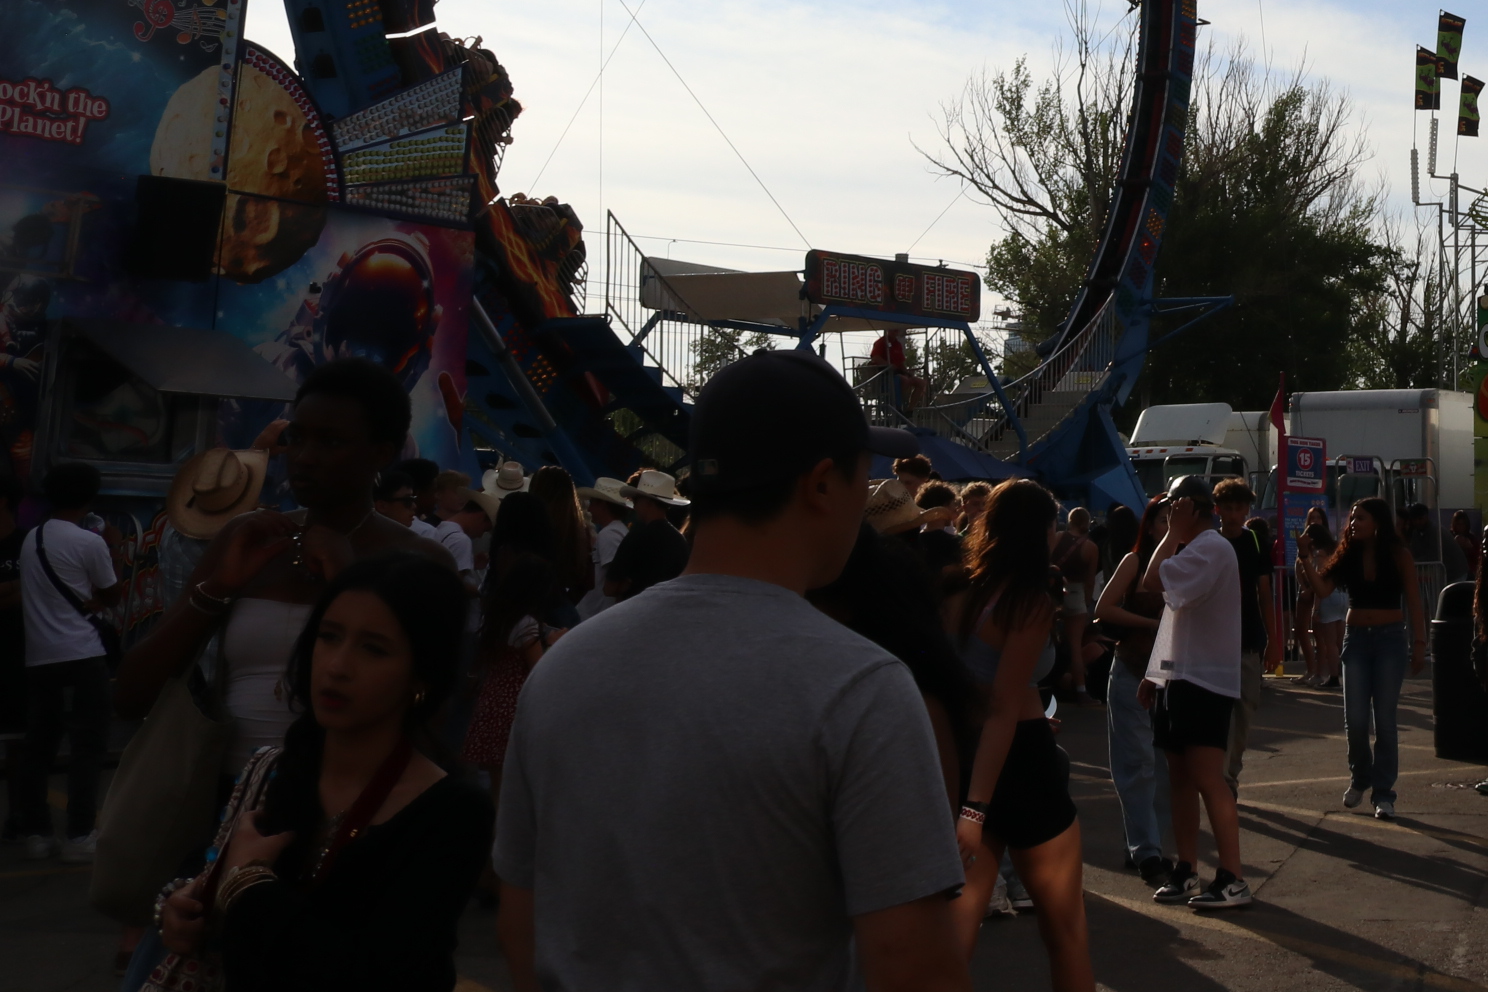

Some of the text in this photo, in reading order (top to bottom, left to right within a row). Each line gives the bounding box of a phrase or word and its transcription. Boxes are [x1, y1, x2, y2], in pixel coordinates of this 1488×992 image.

[0, 81, 106, 117] ock'n the
[0, 104, 86, 143] Planet!
[823, 258, 884, 304] RING
[923, 273, 971, 313] FIRE
[1299, 452, 1311, 466] 15
[1355, 460, 1370, 472] EXIT
[1295, 470, 1315, 478] TICKETS
